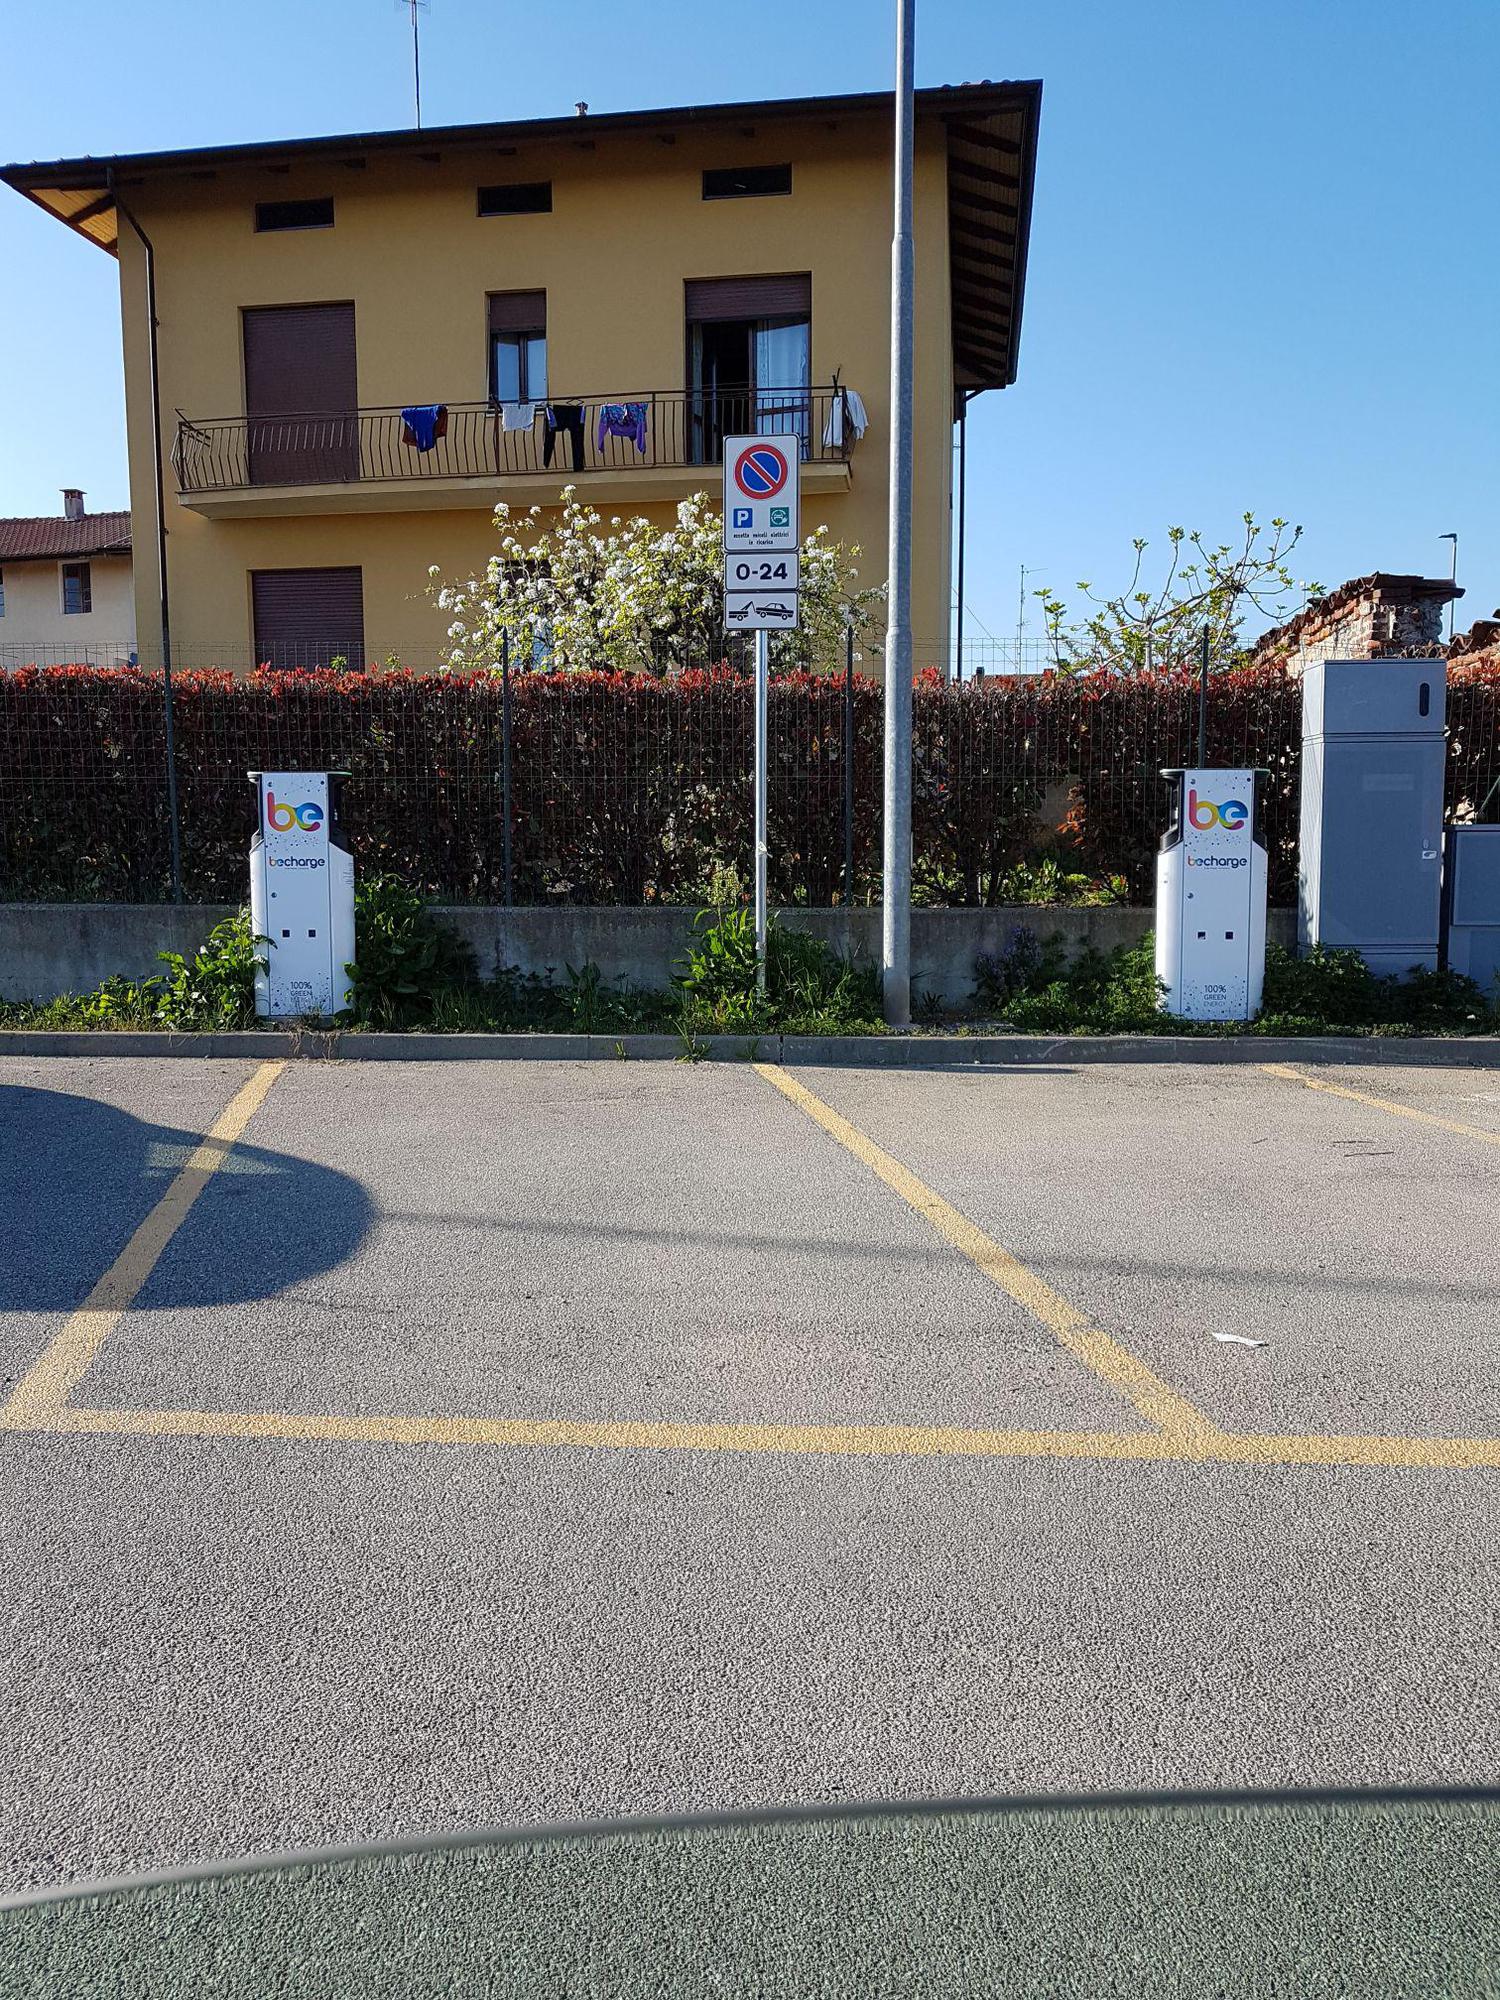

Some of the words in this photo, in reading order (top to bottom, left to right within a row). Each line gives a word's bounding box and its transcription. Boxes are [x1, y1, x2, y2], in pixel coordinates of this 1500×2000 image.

[737, 510, 749, 527] P
[736, 562, 788, 581] 0-24
[267, 791, 324, 832] be
[1188, 789, 1249, 831] be
[268, 855, 325, 869] becharge
[1187, 855, 1248, 869] becharge
[290, 981, 313, 990] 100%
[1204, 984, 1227, 993] 100%
